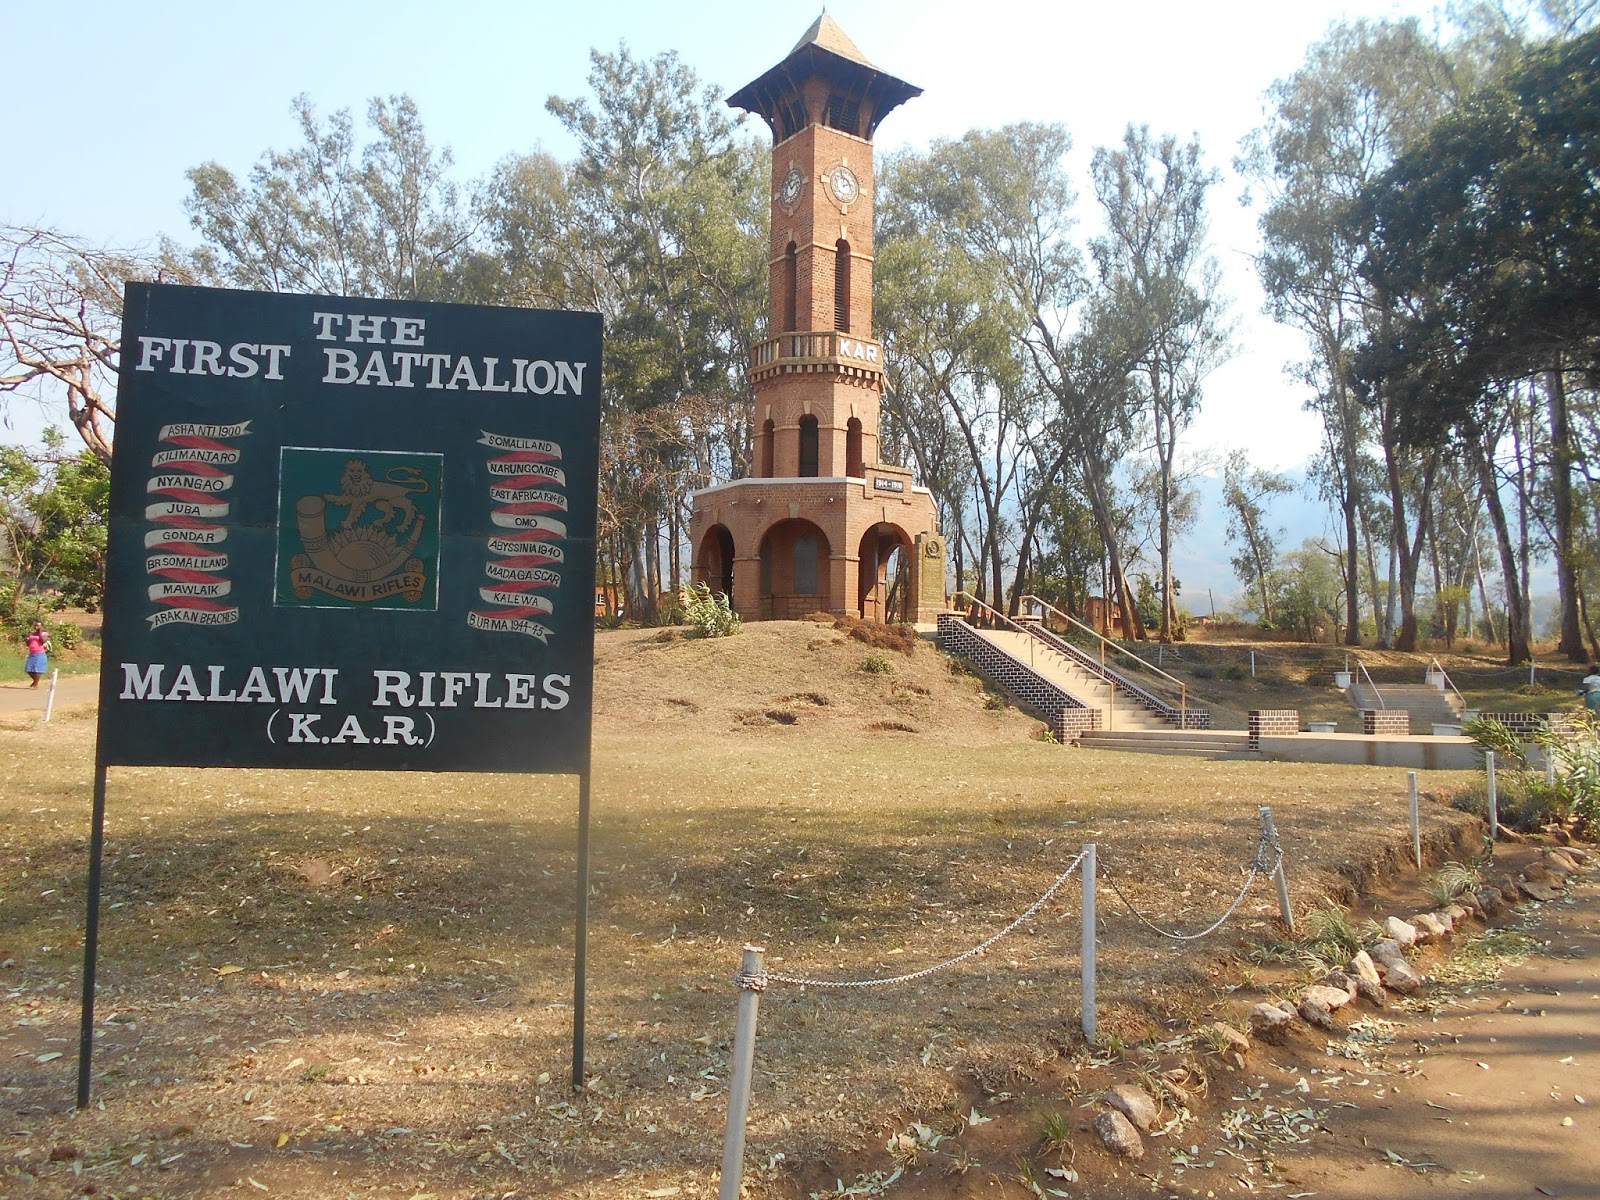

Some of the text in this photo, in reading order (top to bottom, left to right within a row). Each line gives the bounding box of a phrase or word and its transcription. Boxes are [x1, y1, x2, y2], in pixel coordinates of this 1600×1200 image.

[313, 311, 426, 347] THE
[840, 338, 878, 362] KAR
[135, 336, 587, 396] FIRST BATTALION
[167, 424, 241, 437] ASHANTI 1900
[488, 435, 552, 453] SOMALILAND
[157, 450, 237, 464] KILIMANJARO
[490, 463, 560, 479] NARUNGOMBE
[157, 476, 225, 491] NYANGAO
[491, 488, 511, 501] EAST
[511, 490, 543, 502] AFRICA
[166, 503, 201, 516] JUBA
[514, 517, 538, 528] OMO
[162, 531, 215, 542] GONDAR
[489, 540, 561, 558] ABYSSINIA 1940
[487, 565, 560, 585] MADAGASCAR
[163, 584, 219, 595] MAWLAIK
[298, 572, 421, 598] MALAWI RIFLES
[493, 592, 539, 607] KALEWA
[155, 610, 237, 626] ARAKAN BEACHES
[469, 613, 545, 637] BURMA 1944-45
[120, 662, 571, 710] MALAWI RIFLES
[266, 709, 436, 749] (K.A.R.)
